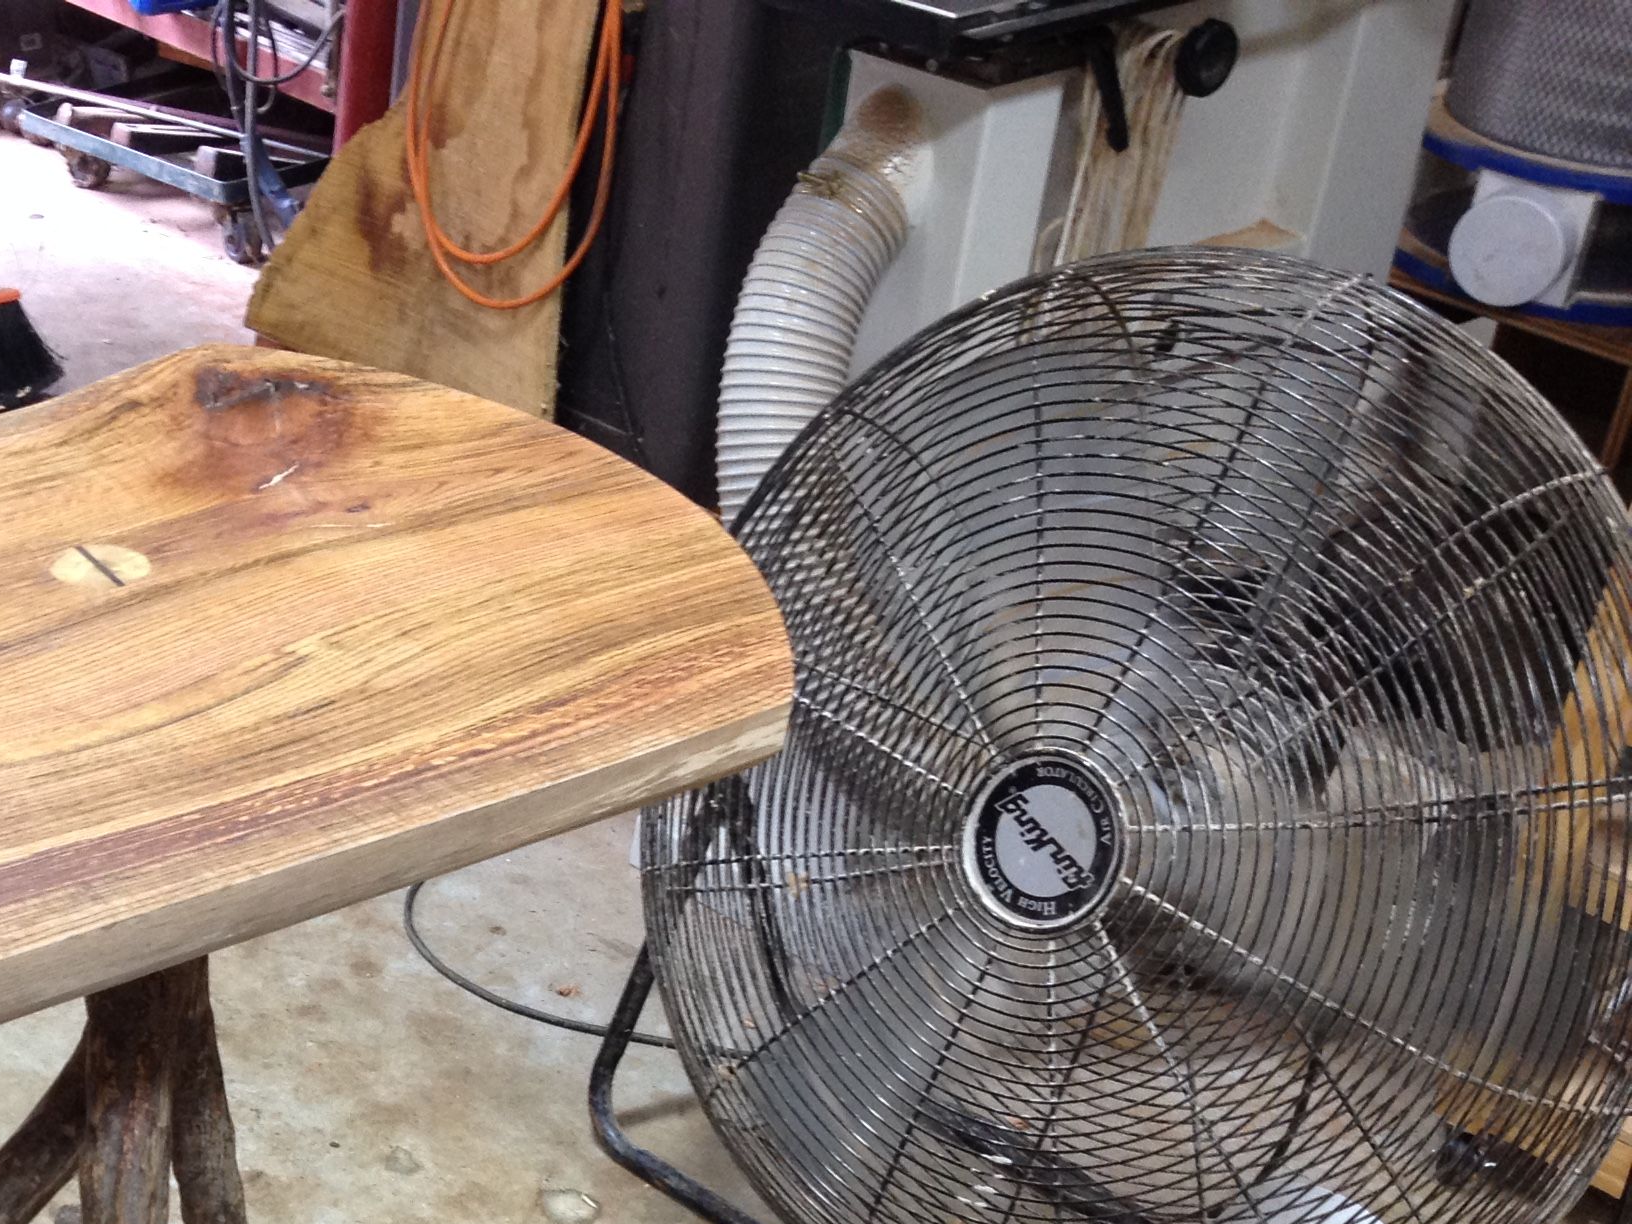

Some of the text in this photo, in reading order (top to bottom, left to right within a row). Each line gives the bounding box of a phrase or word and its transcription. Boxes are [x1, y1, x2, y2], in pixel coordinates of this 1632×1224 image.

[1036, 766, 1112, 846] AIR CIRCULATOR
[981, 834, 1058, 916] HIGH VELOCITY
